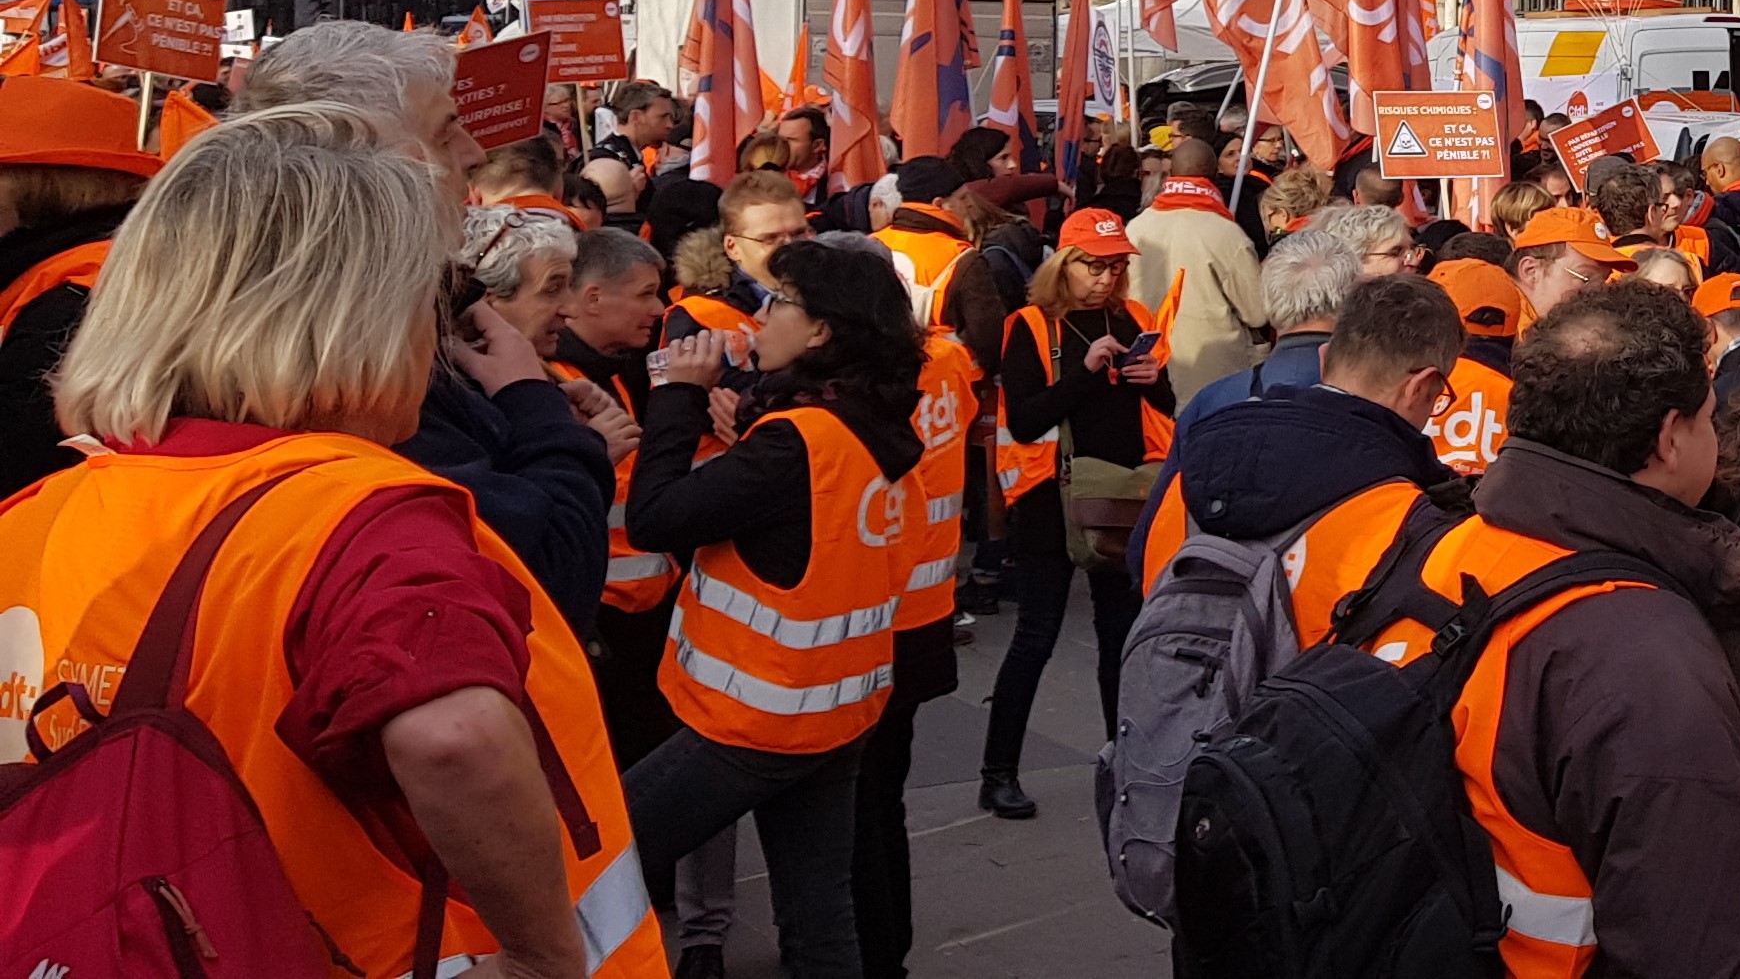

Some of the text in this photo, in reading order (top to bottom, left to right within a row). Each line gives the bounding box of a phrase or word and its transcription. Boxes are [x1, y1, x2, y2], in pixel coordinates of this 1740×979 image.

[147, 13, 163, 28] CE
[199, 23, 221, 39] PAS
[1444, 124, 1456, 134] ET
[1429, 137, 1495, 147] CE N'EST PAS
[1436, 149, 1480, 160] PÉNIBLE
